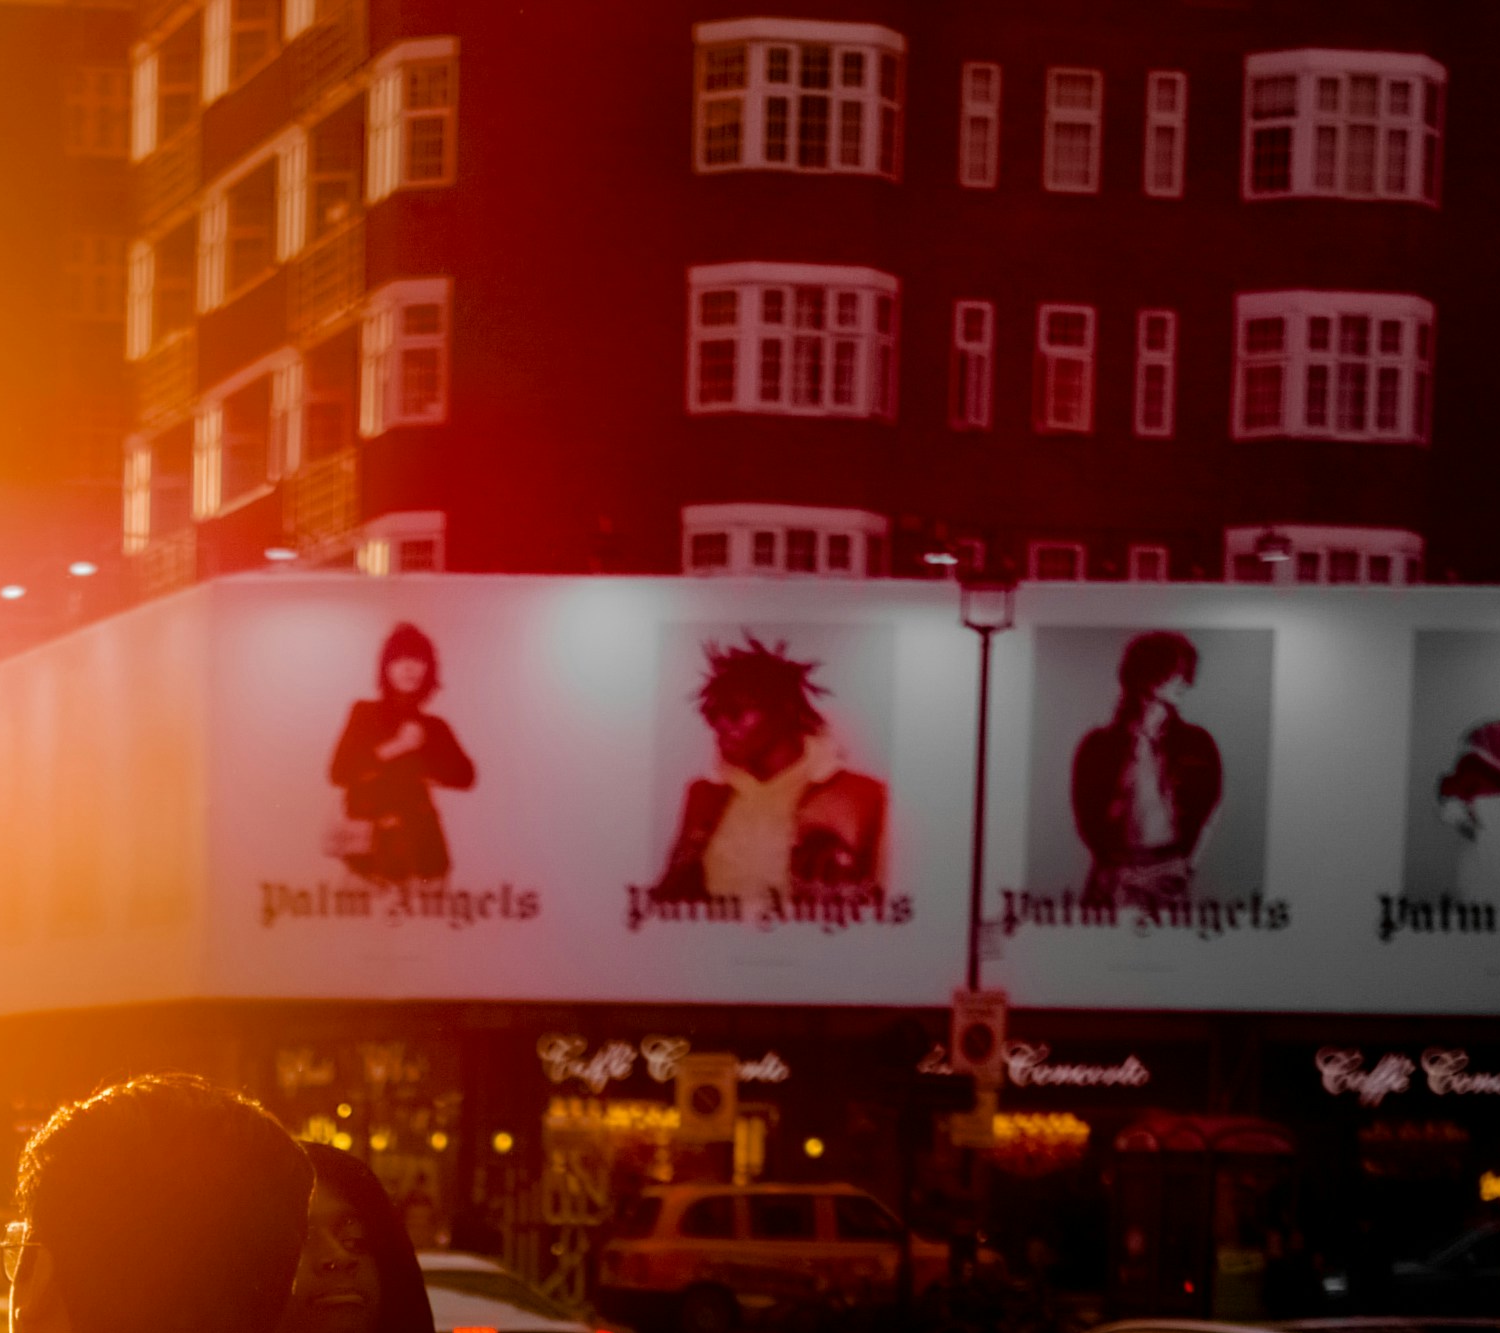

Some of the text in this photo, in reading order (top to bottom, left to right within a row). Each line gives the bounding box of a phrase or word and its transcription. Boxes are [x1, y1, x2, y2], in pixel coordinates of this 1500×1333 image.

[259, 880, 541, 929] Palm Angels
[625, 884, 914, 934] Palm Angels
[1001, 890, 1290, 941] Palm Angels
[1377, 893, 1496, 944] Palm
